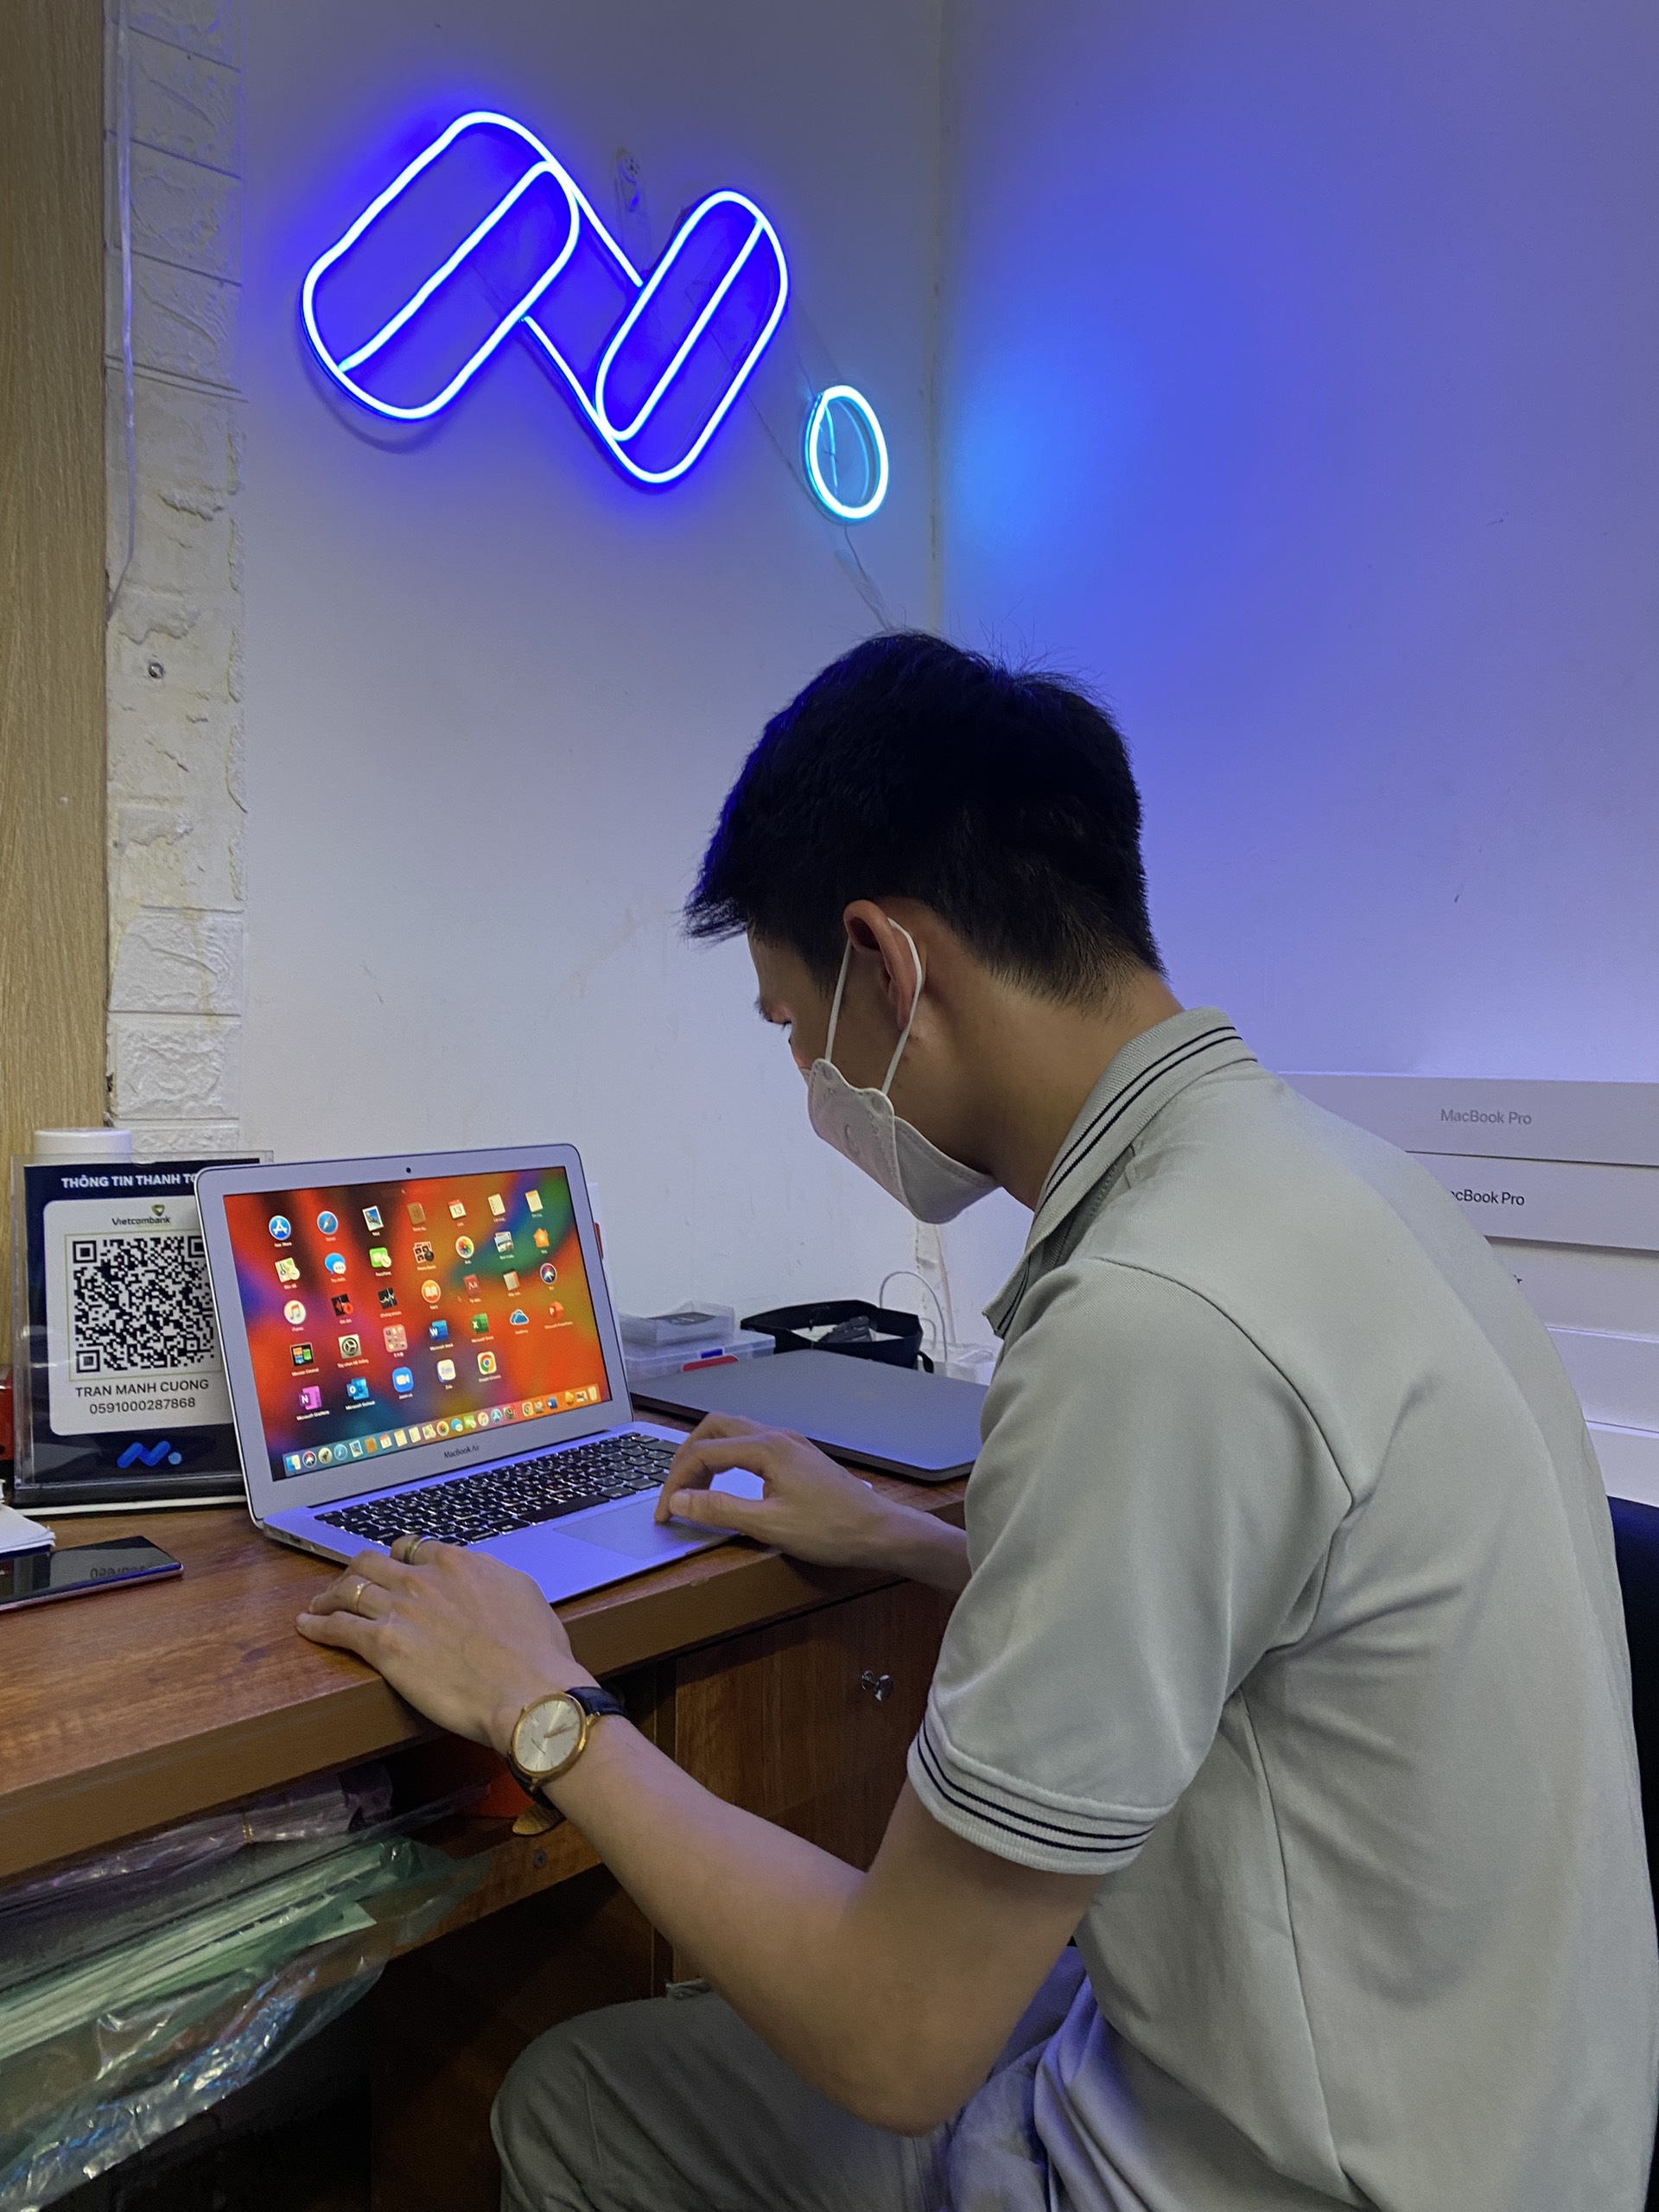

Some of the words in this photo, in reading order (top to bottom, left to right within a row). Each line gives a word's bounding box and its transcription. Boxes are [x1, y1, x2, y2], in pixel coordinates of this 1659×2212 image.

[1440, 1109, 1504, 1124] MacBook
[1509, 1111, 1532, 1125] Pro
[60, 1173, 109, 1189] THÔNG
[111, 1175, 134, 1187] TIN
[135, 1173, 181, 1187] THANH
[1502, 1192, 1525, 1206] Pro
[111, 1215, 170, 1226] Vietcombank
[75, 1385, 112, 1398] TRAN
[116, 1382, 157, 1395] MANH
[160, 1379, 209, 1393] CUONG
[89, 1397, 196, 1414] 0591000287868
